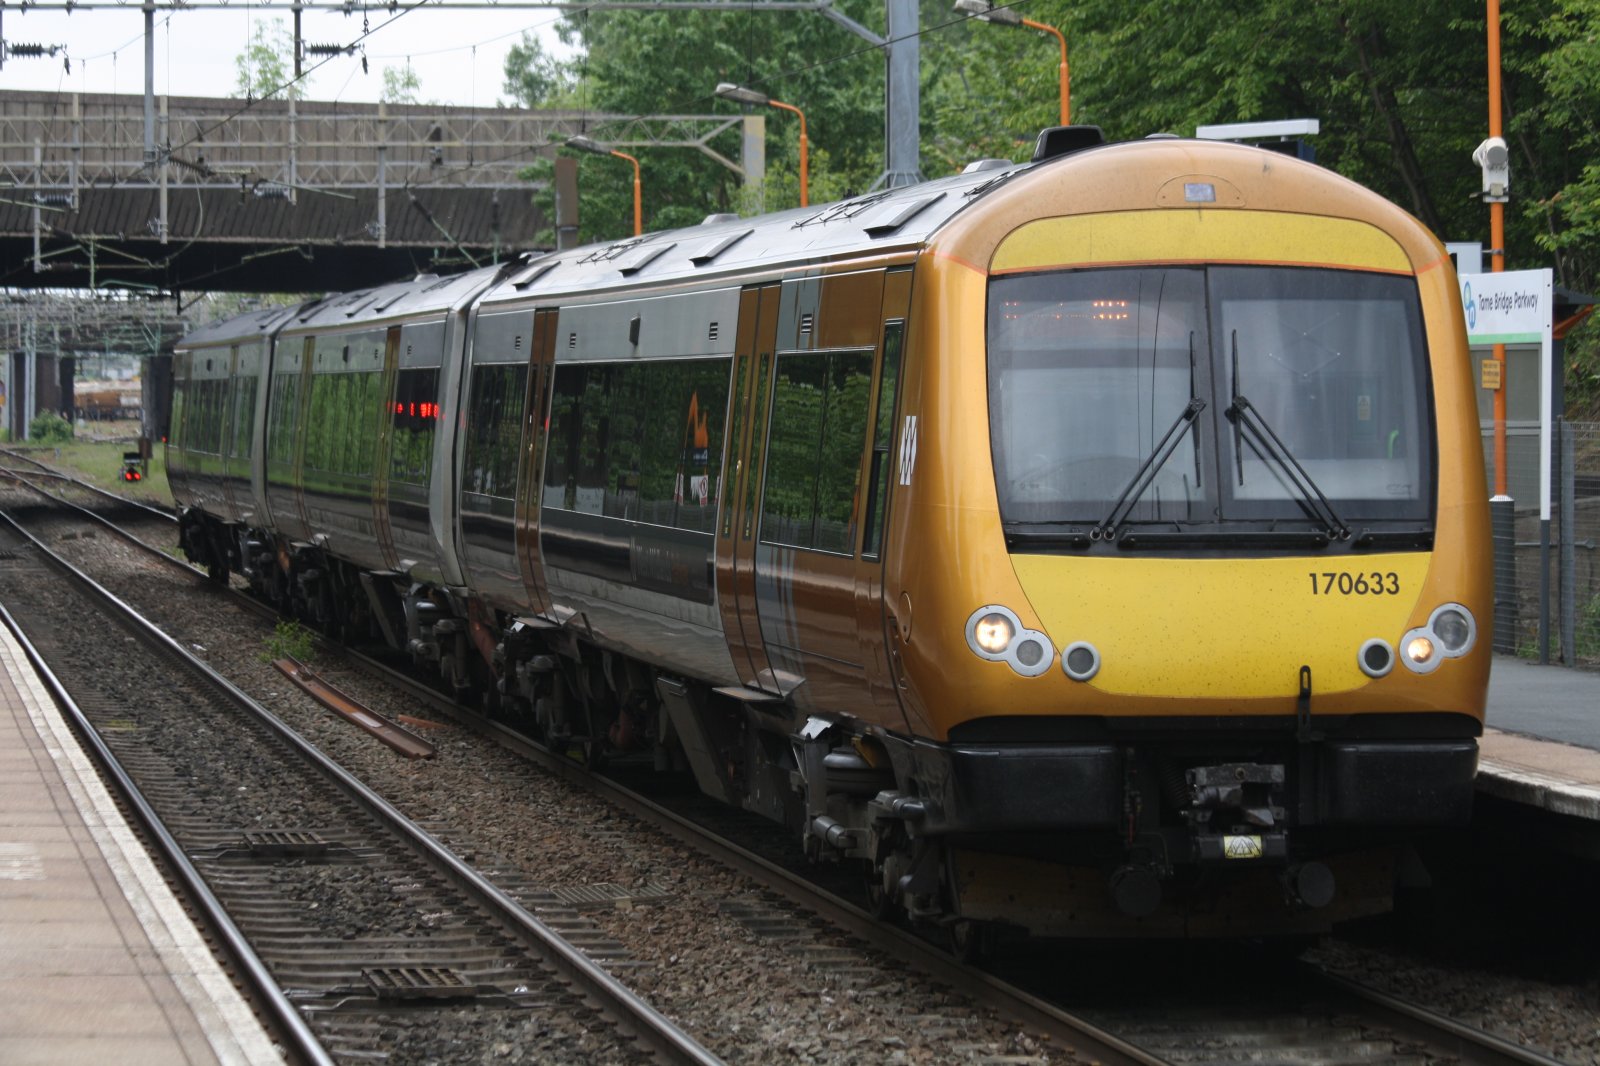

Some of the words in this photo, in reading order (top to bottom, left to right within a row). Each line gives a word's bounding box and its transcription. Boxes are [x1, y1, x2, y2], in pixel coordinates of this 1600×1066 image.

[1478, 293, 1493, 311] Tame
[1494, 292, 1513, 315] Bridge
[1514, 290, 1538, 313] Parkway
[1308, 572, 1400, 596] 170633
